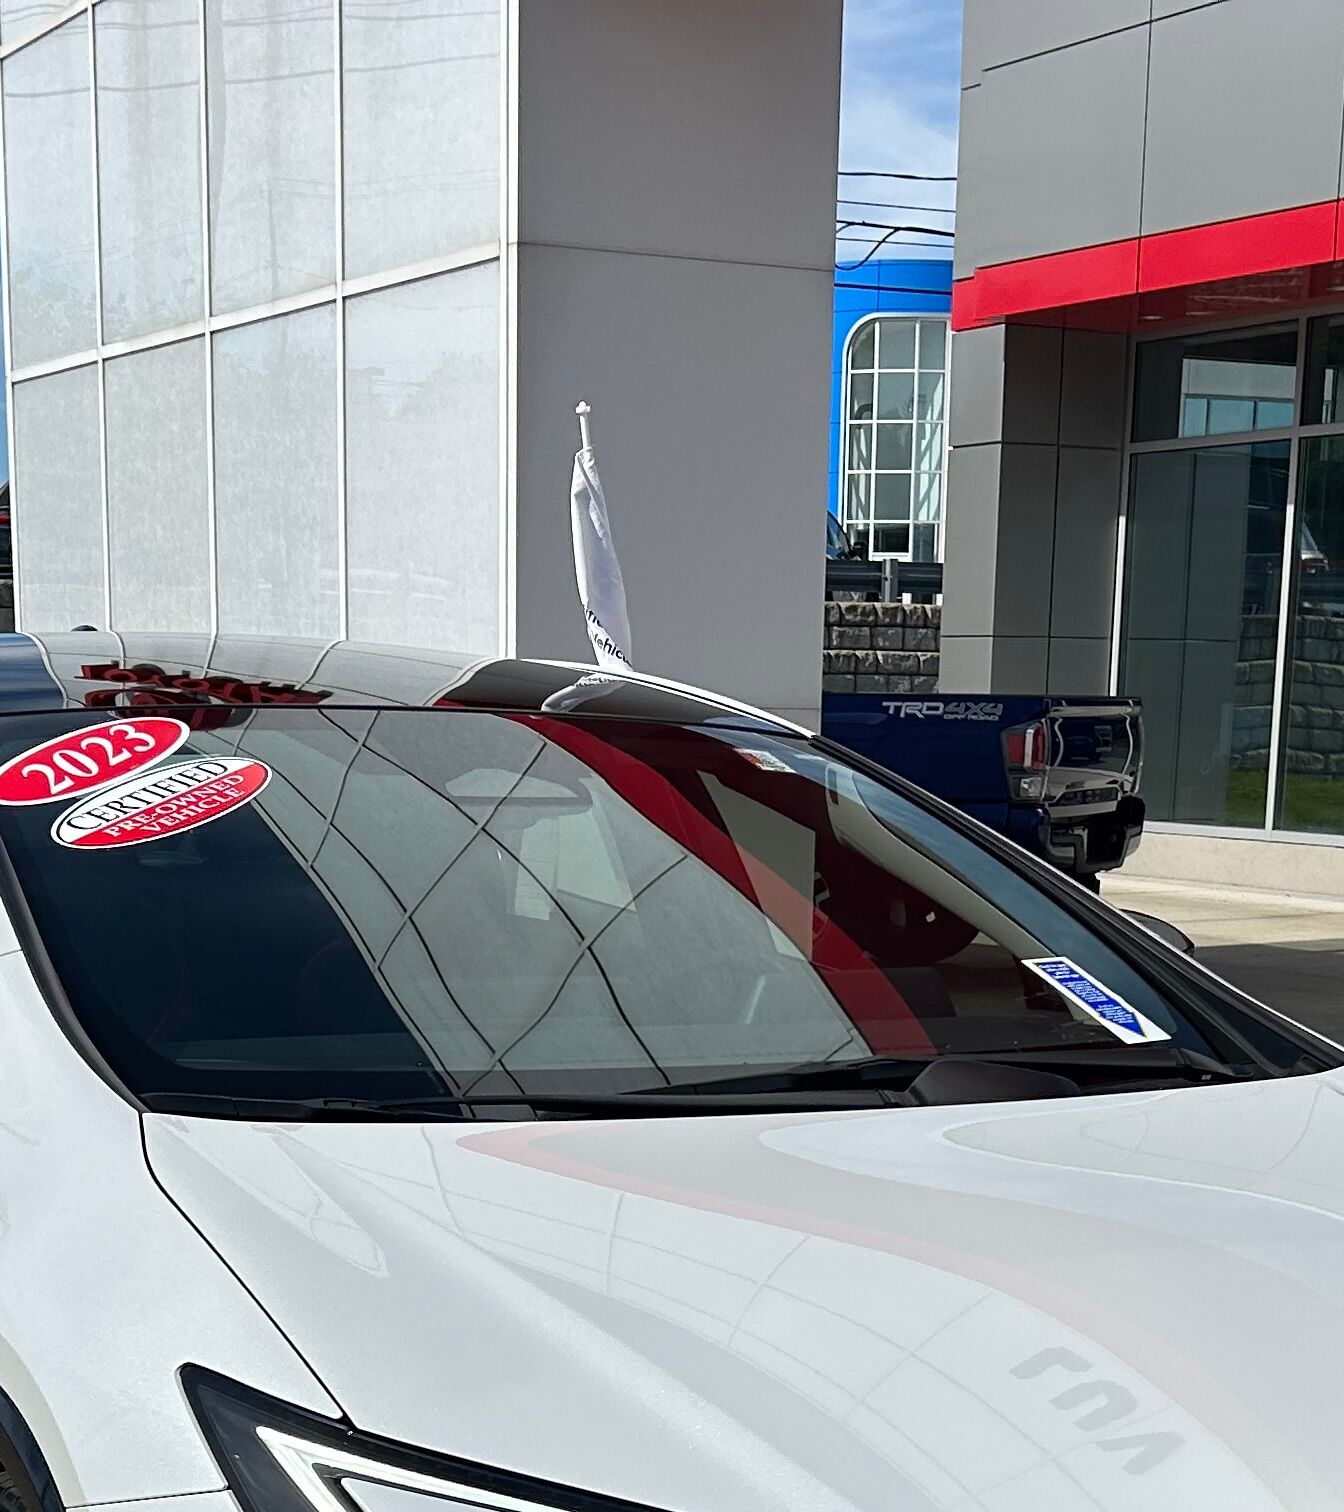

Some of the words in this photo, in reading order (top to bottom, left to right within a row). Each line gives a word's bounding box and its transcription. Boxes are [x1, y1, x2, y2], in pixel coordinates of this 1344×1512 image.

[881, 701, 944, 719] TRD
[22, 723, 157, 795] 2023
[66, 761, 229, 830] CERTIFIED
[104, 773, 245, 837] PRE-OWNED
[140, 787, 245, 834] VEHICLE
